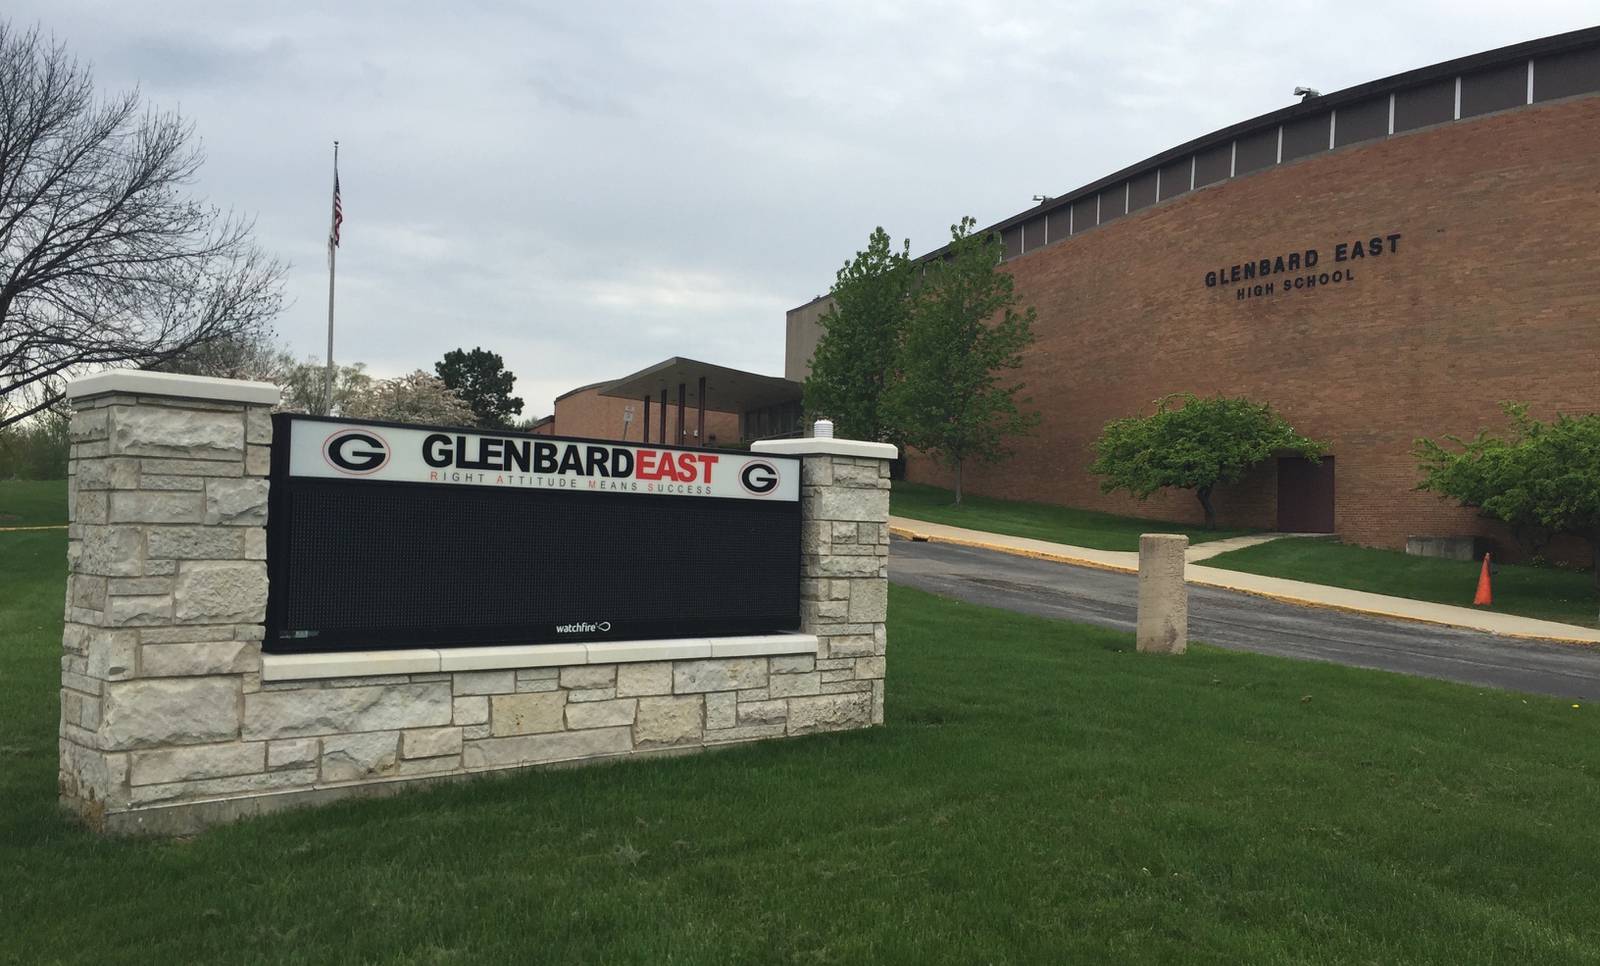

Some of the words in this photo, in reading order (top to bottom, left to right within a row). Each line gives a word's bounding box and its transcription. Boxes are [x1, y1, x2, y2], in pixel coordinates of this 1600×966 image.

[1205, 249, 1319, 288] GLENBARD
[1335, 233, 1401, 262] EAST
[1236, 282, 1275, 301] HIGH
[1283, 268, 1355, 292] SCHOOL
[328, 433, 386, 471] G
[430, 471, 485, 484] RIGHT
[496, 474, 578, 488] ATTITUDE
[588, 479, 638, 491] MEANS
[647, 483, 713, 495] SUCCESS
[741, 463, 778, 493] G
[556, 622, 596, 633] watchfire
